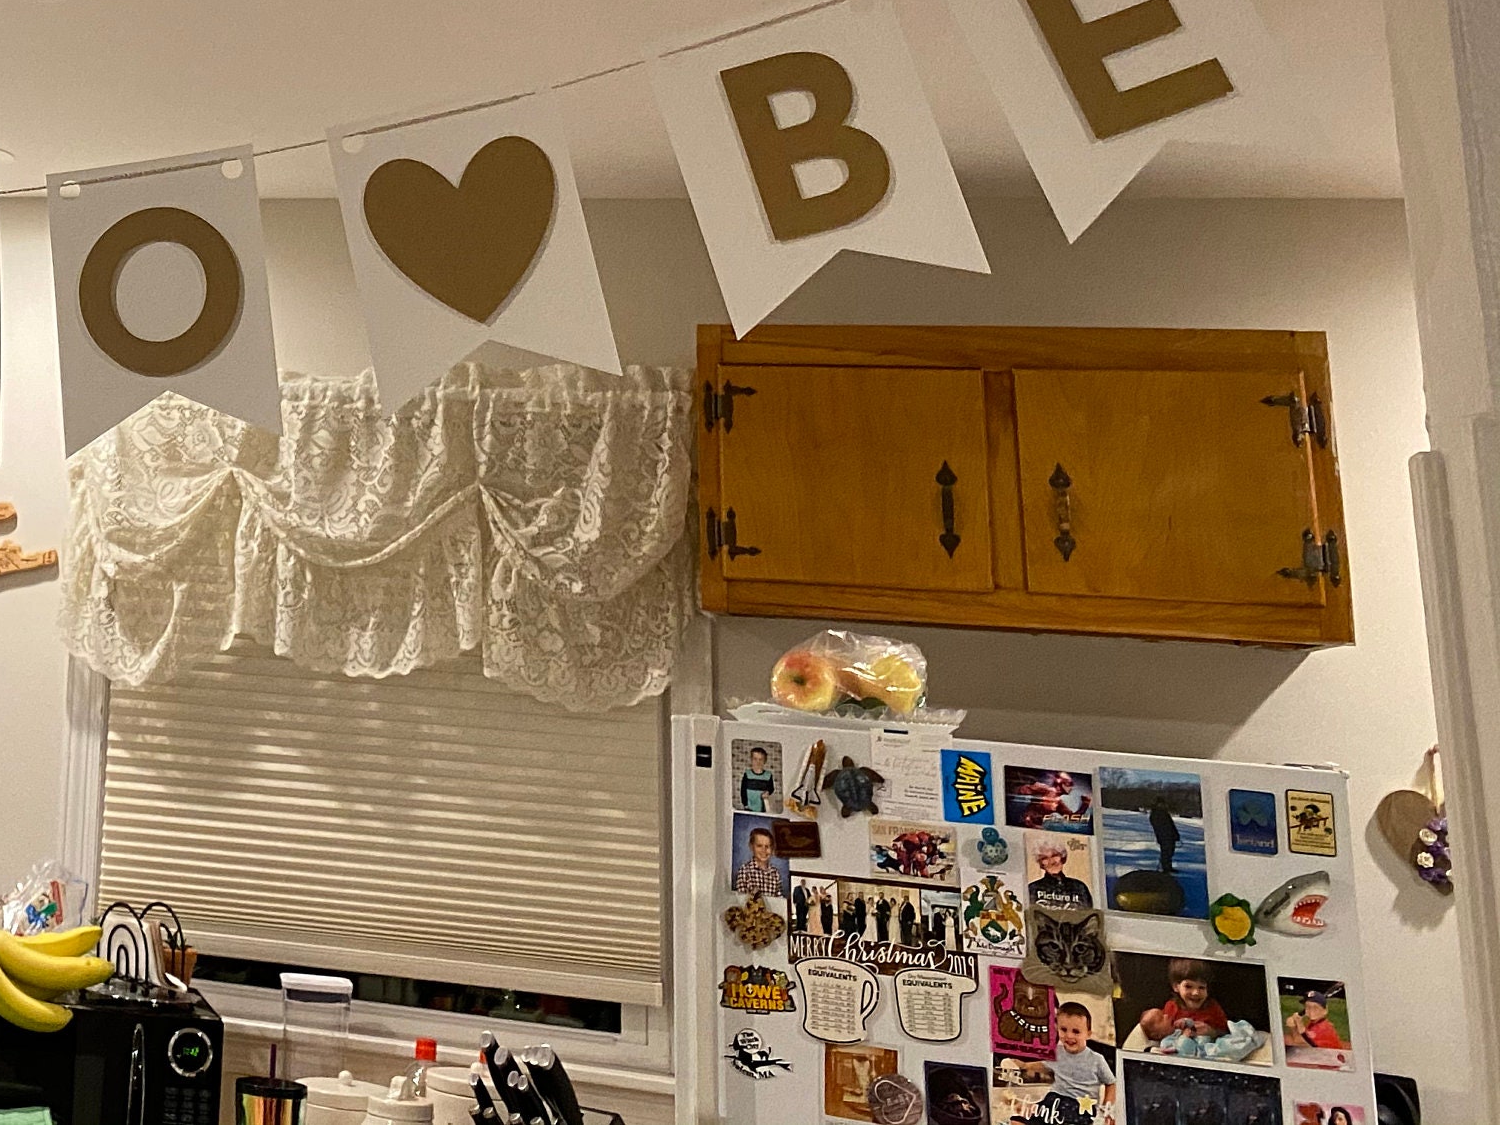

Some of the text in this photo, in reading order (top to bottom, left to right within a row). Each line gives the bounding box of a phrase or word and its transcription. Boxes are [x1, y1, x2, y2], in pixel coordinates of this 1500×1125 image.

[1042, 812, 1091, 824] FLASH
[1037, 890, 1071, 902] Picture
[789, 935, 827, 957] MERRY
[828, 930, 947, 970] Christmas
[948, 953, 976, 977] 2019
[808, 968, 858, 983] EQUIVALENTS
[731, 983, 782, 1000] HOWE
[902, 979, 953, 990] EQUIVALENTS
[730, 996, 785, 1011] CAVERNS
